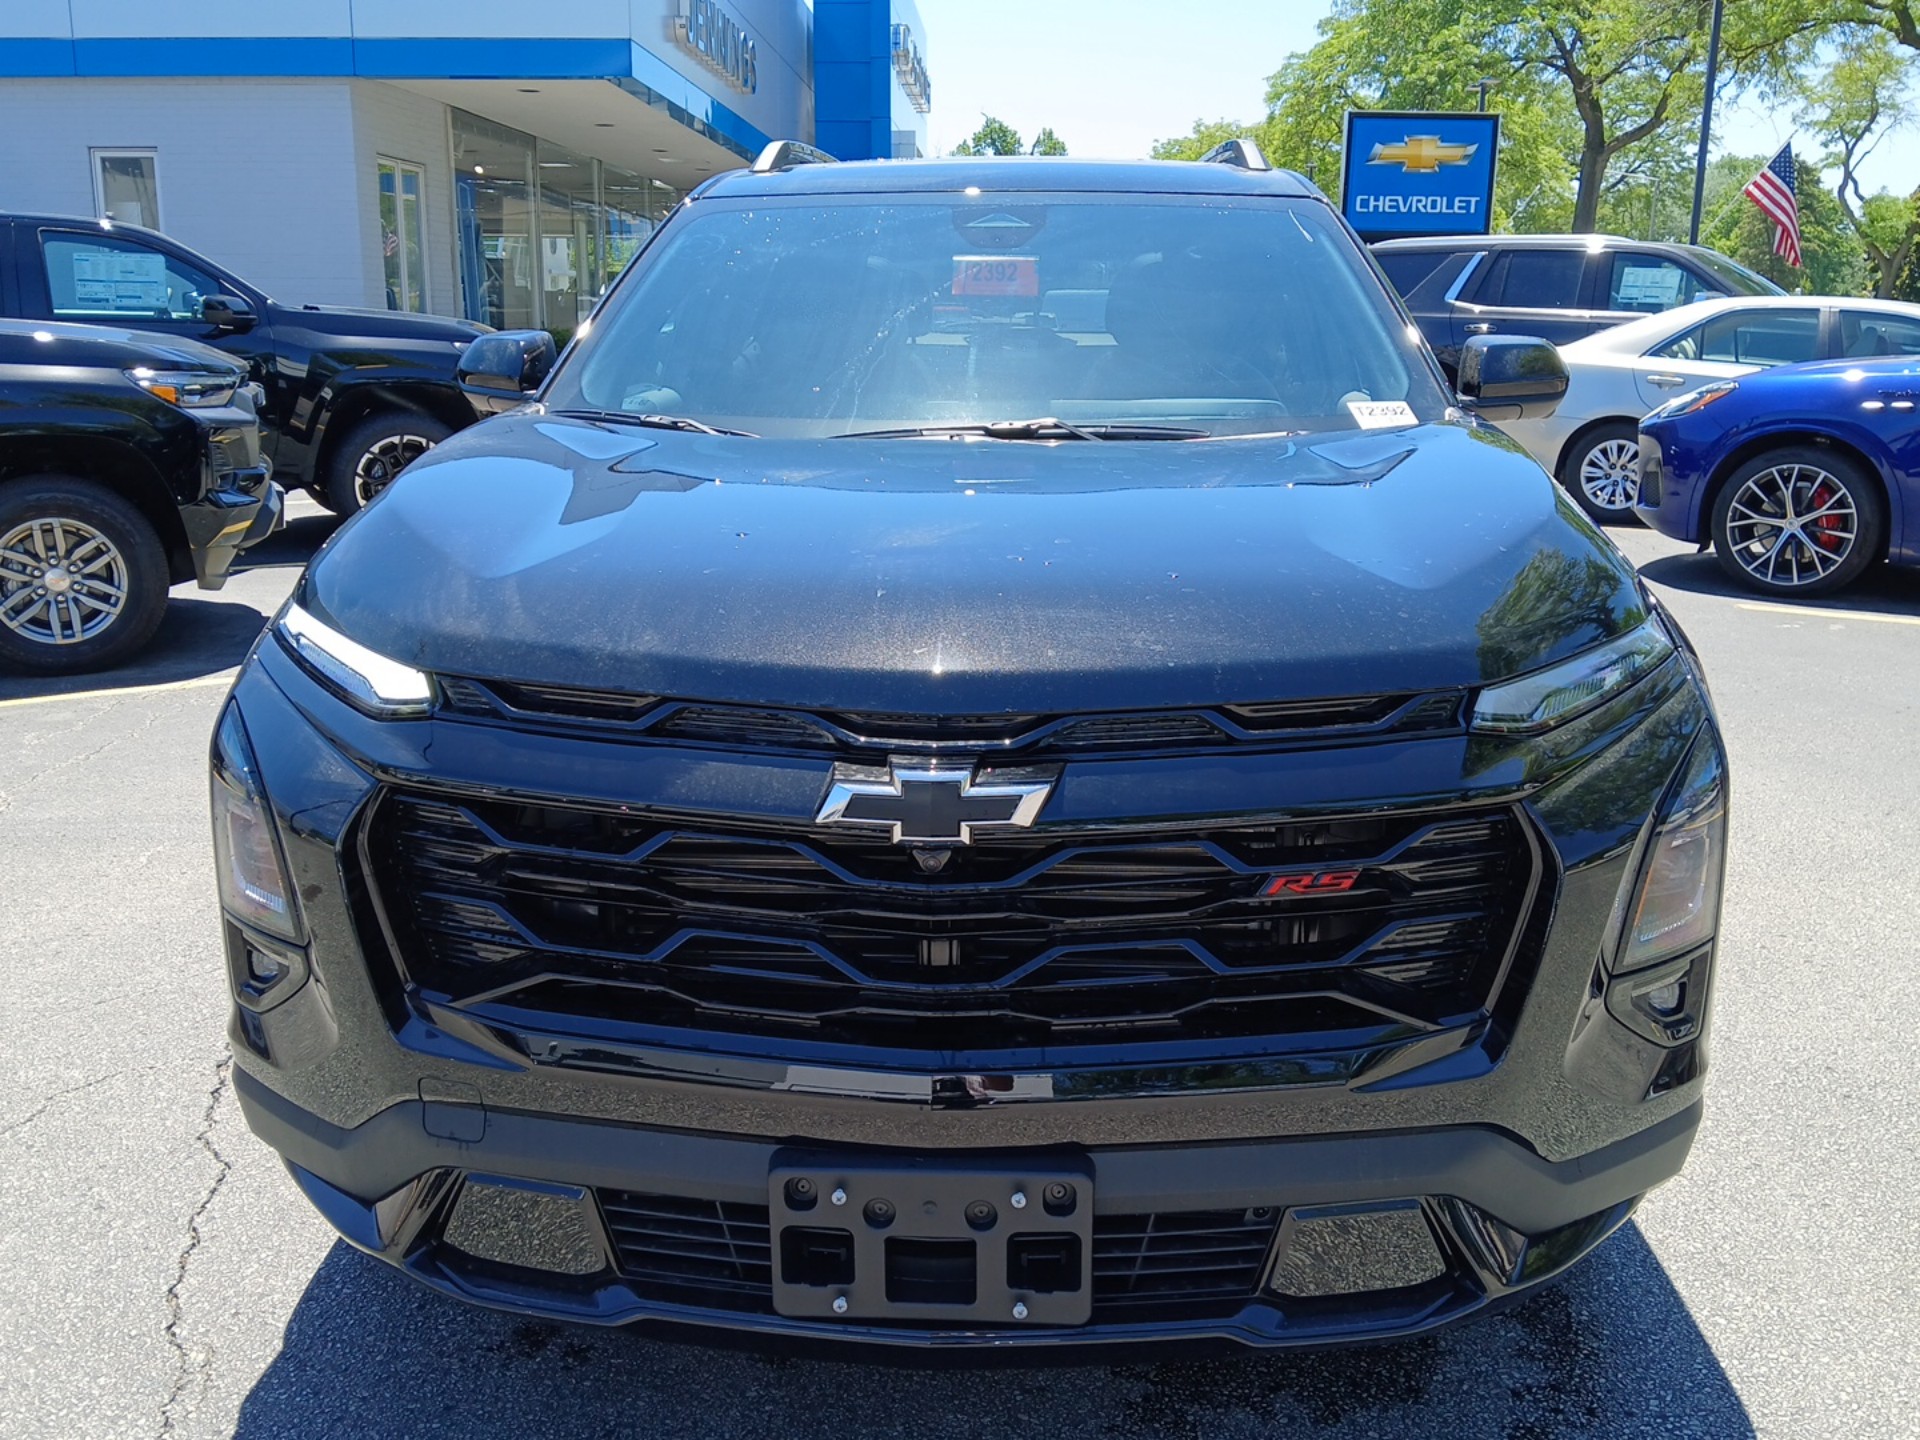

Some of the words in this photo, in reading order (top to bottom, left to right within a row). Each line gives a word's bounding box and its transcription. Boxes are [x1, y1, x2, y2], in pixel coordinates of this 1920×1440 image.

[1355, 195, 1481, 214] CHEVROLET
[971, 262, 1018, 282] 2392
[1260, 869, 1361, 896] RS
